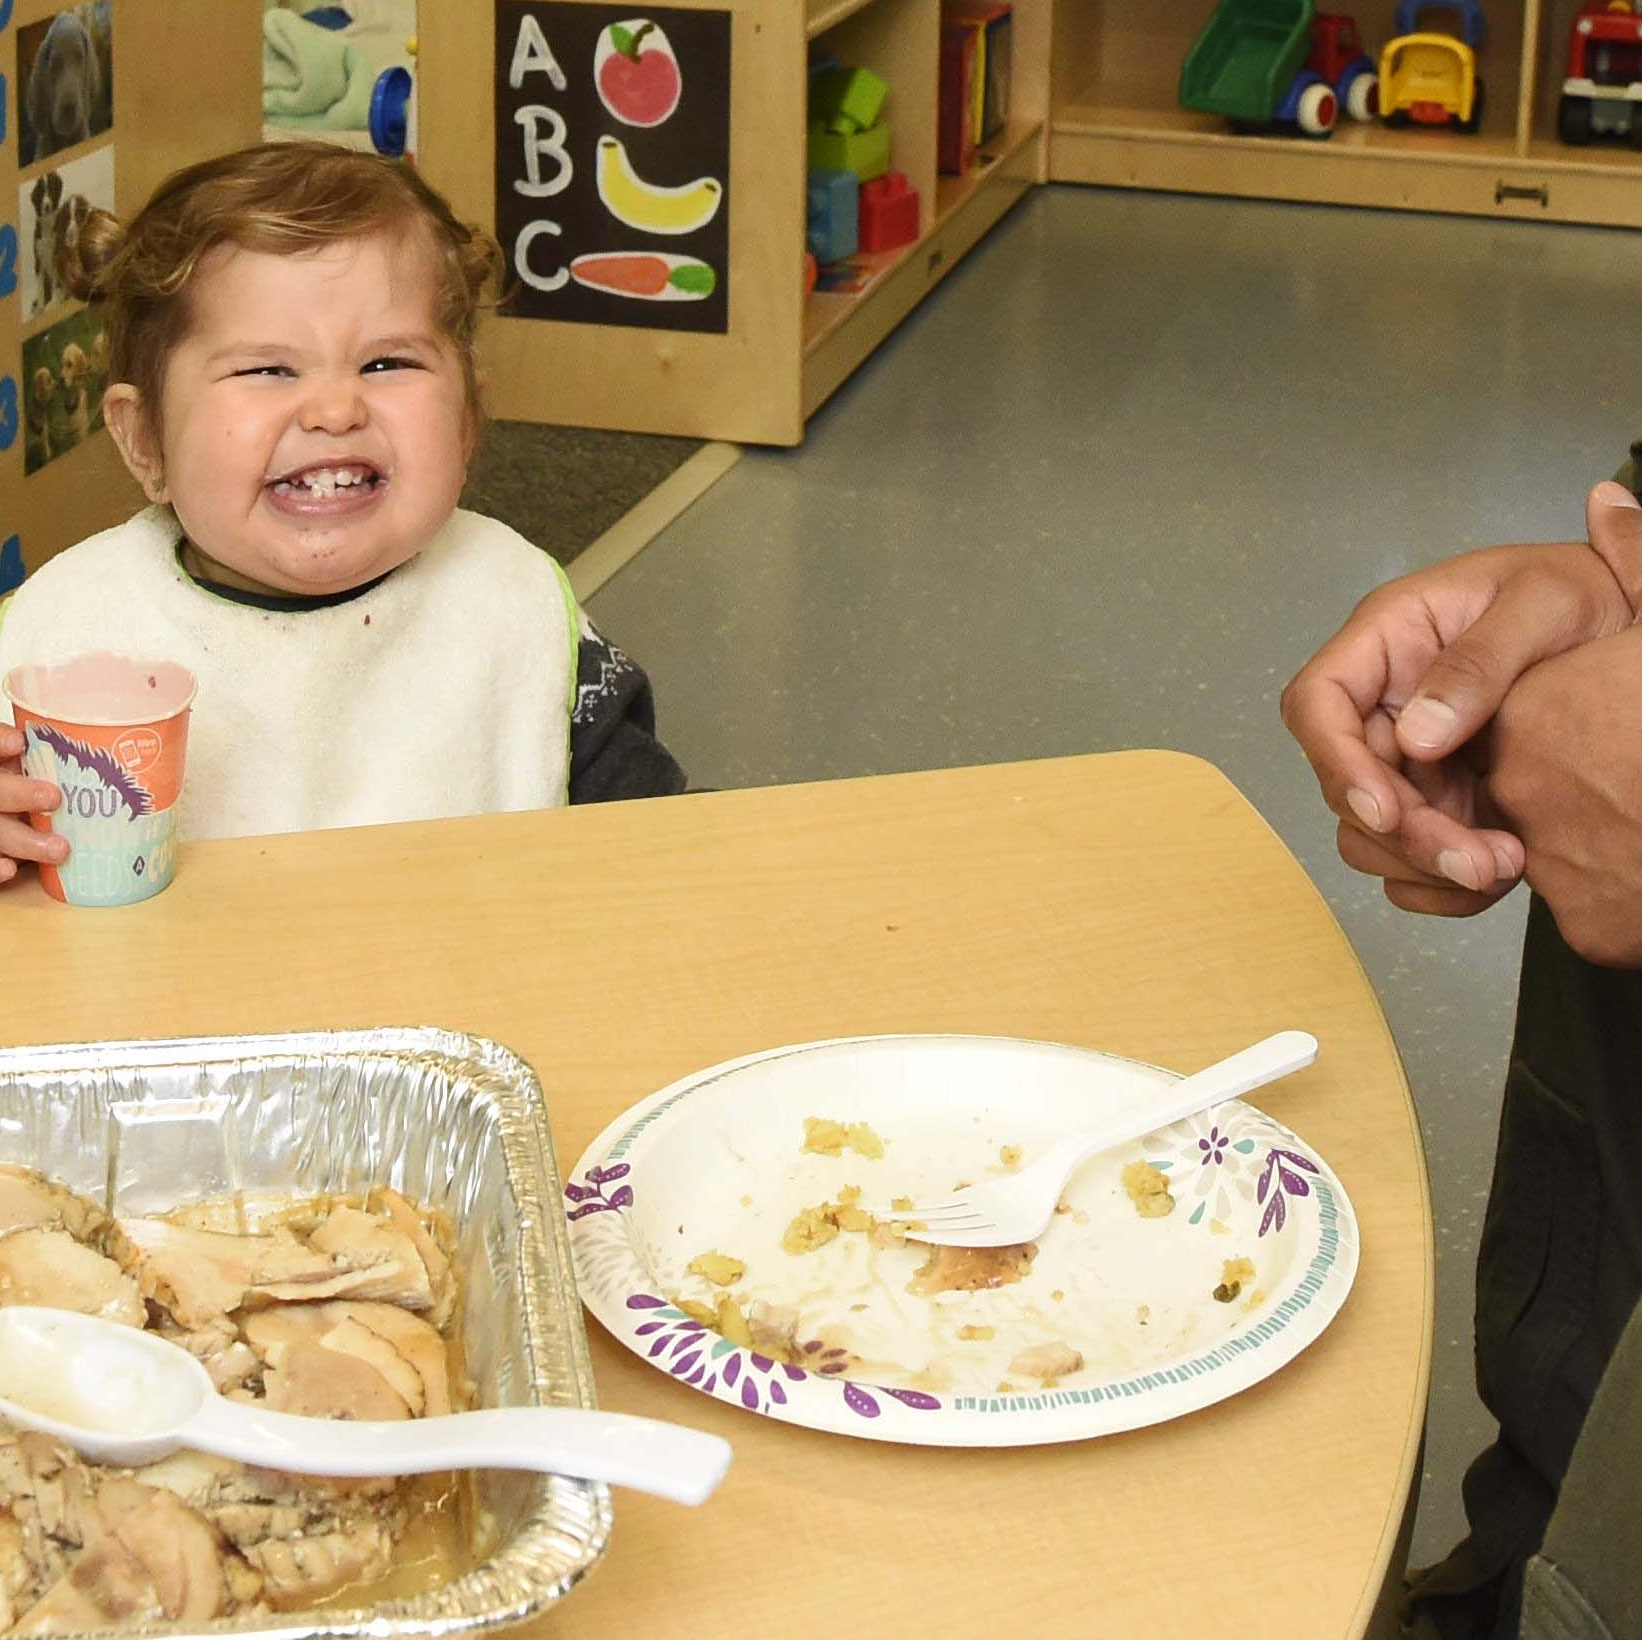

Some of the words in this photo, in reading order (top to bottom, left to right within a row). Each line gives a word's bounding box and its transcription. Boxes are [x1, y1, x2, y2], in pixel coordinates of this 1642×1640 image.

[509, 14, 567, 91] A
[514, 104, 573, 198] B
[514, 219, 570, 291] C
[61, 783, 118, 819] YOU
